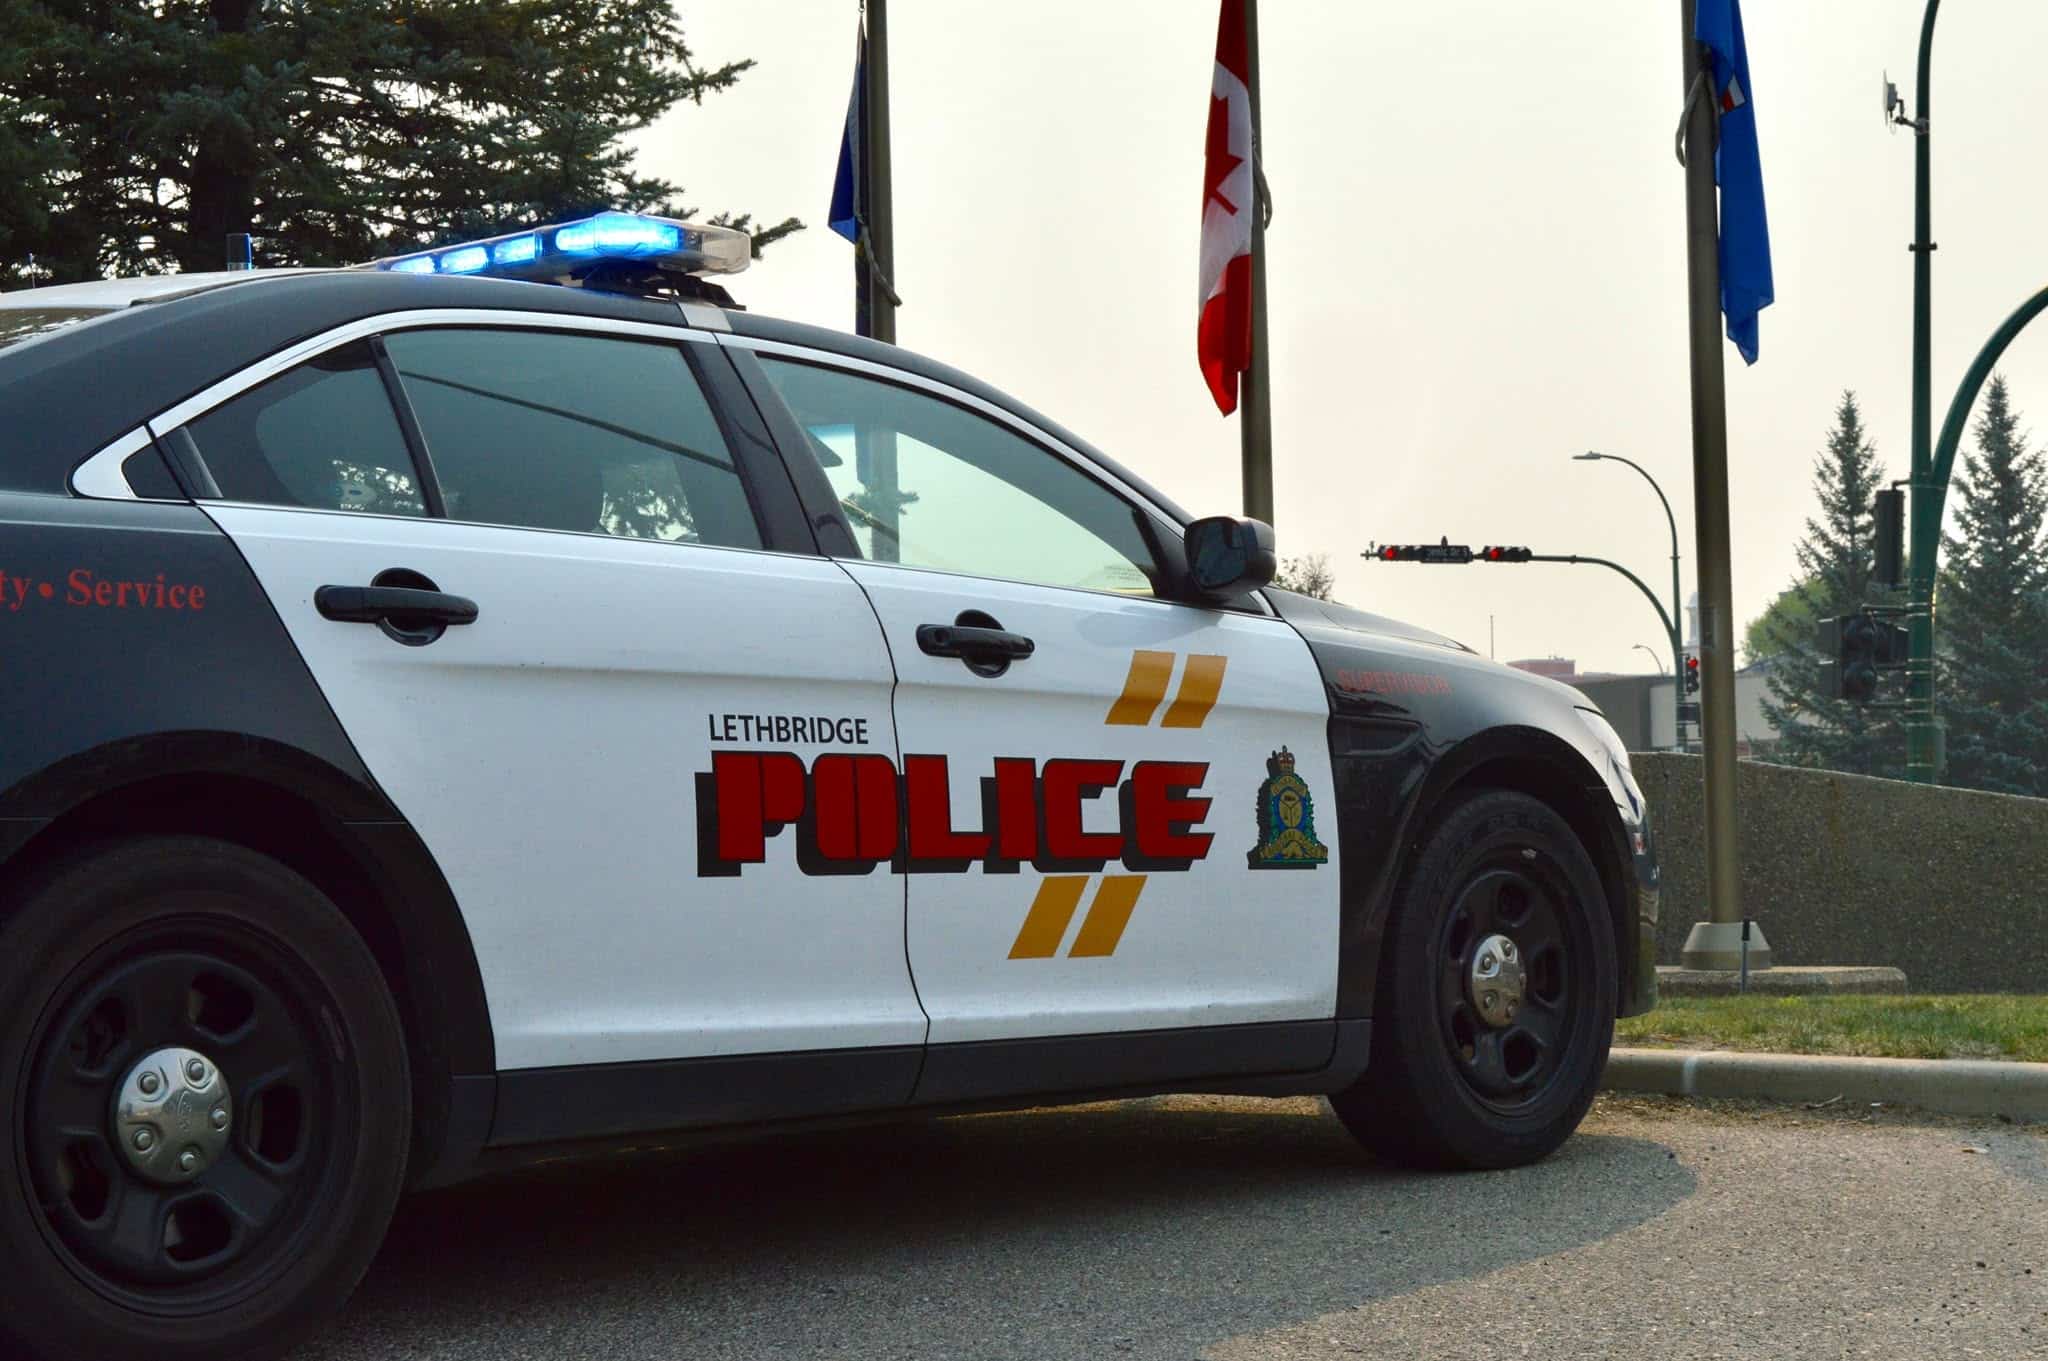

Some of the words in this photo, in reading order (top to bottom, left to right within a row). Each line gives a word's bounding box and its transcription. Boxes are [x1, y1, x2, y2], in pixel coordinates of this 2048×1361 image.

[66, 569, 205, 608] Service
[709, 714, 868, 745] LETHBRIDGE
[695, 751, 1216, 877] POLICE
